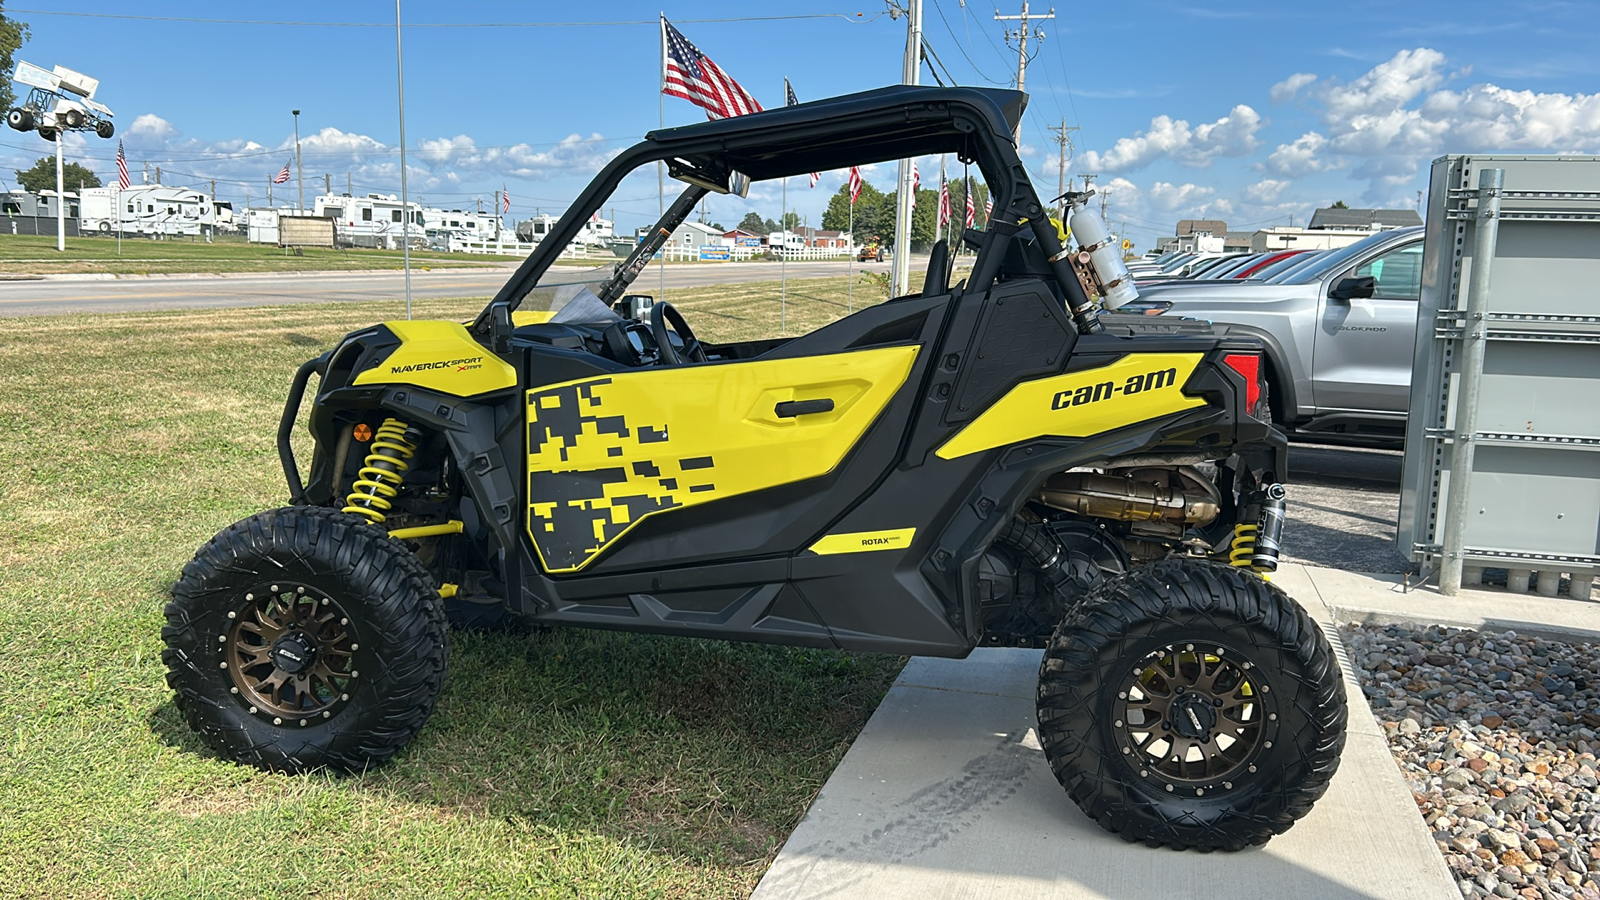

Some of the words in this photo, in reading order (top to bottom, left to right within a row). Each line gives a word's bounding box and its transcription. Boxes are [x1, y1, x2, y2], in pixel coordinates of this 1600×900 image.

[391, 361, 451, 374] MAVERICK
[451, 357, 483, 365] SPORT
[1051, 368, 1177, 411] can-am
[861, 537, 889, 546] ROTAX
